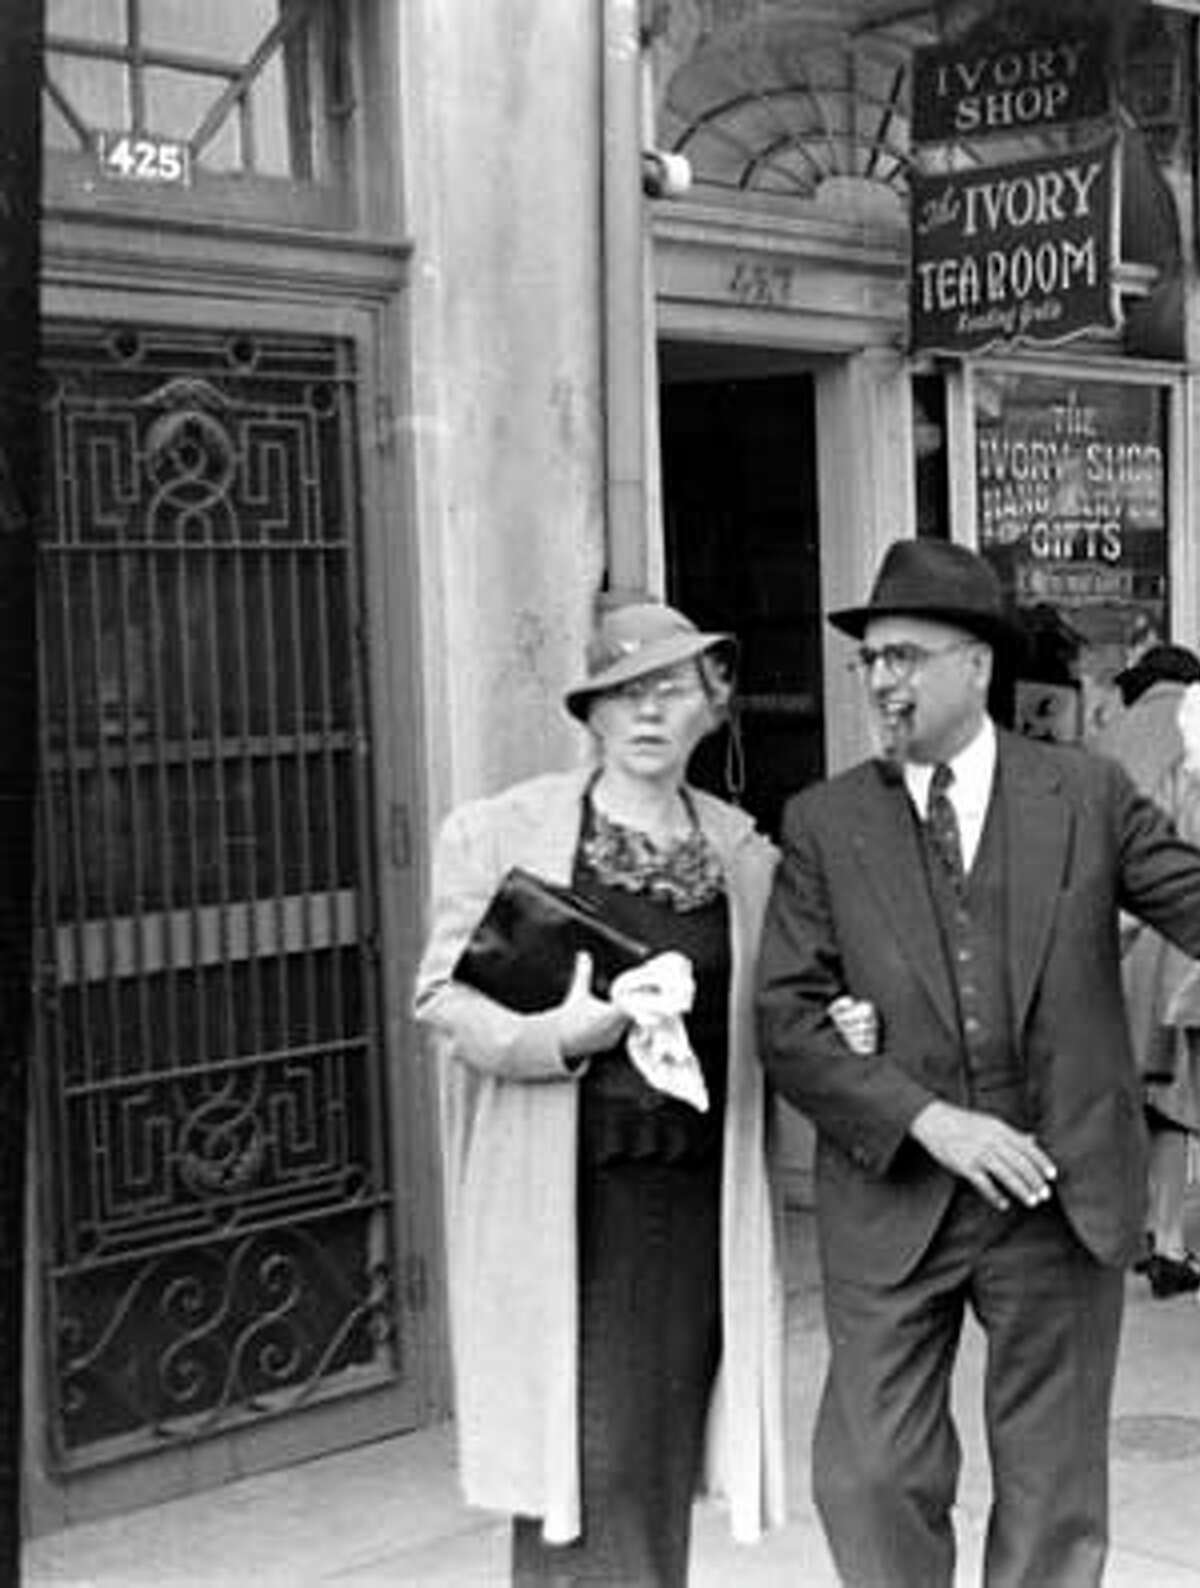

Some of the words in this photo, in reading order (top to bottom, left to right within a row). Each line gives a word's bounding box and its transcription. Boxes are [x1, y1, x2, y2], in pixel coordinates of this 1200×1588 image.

[937, 43, 1084, 96] IVORY
[954, 82, 1068, 131] SHOP
[107, 138, 182, 181] 425
[962, 162, 1101, 236] IVORY
[917, 252, 980, 313] TEA
[985, 236, 1097, 301] ROOM
[978, 439, 1069, 480] IVORY
[1085, 441, 1162, 482] SHOP
[1030, 520, 1122, 562] GIFTS
